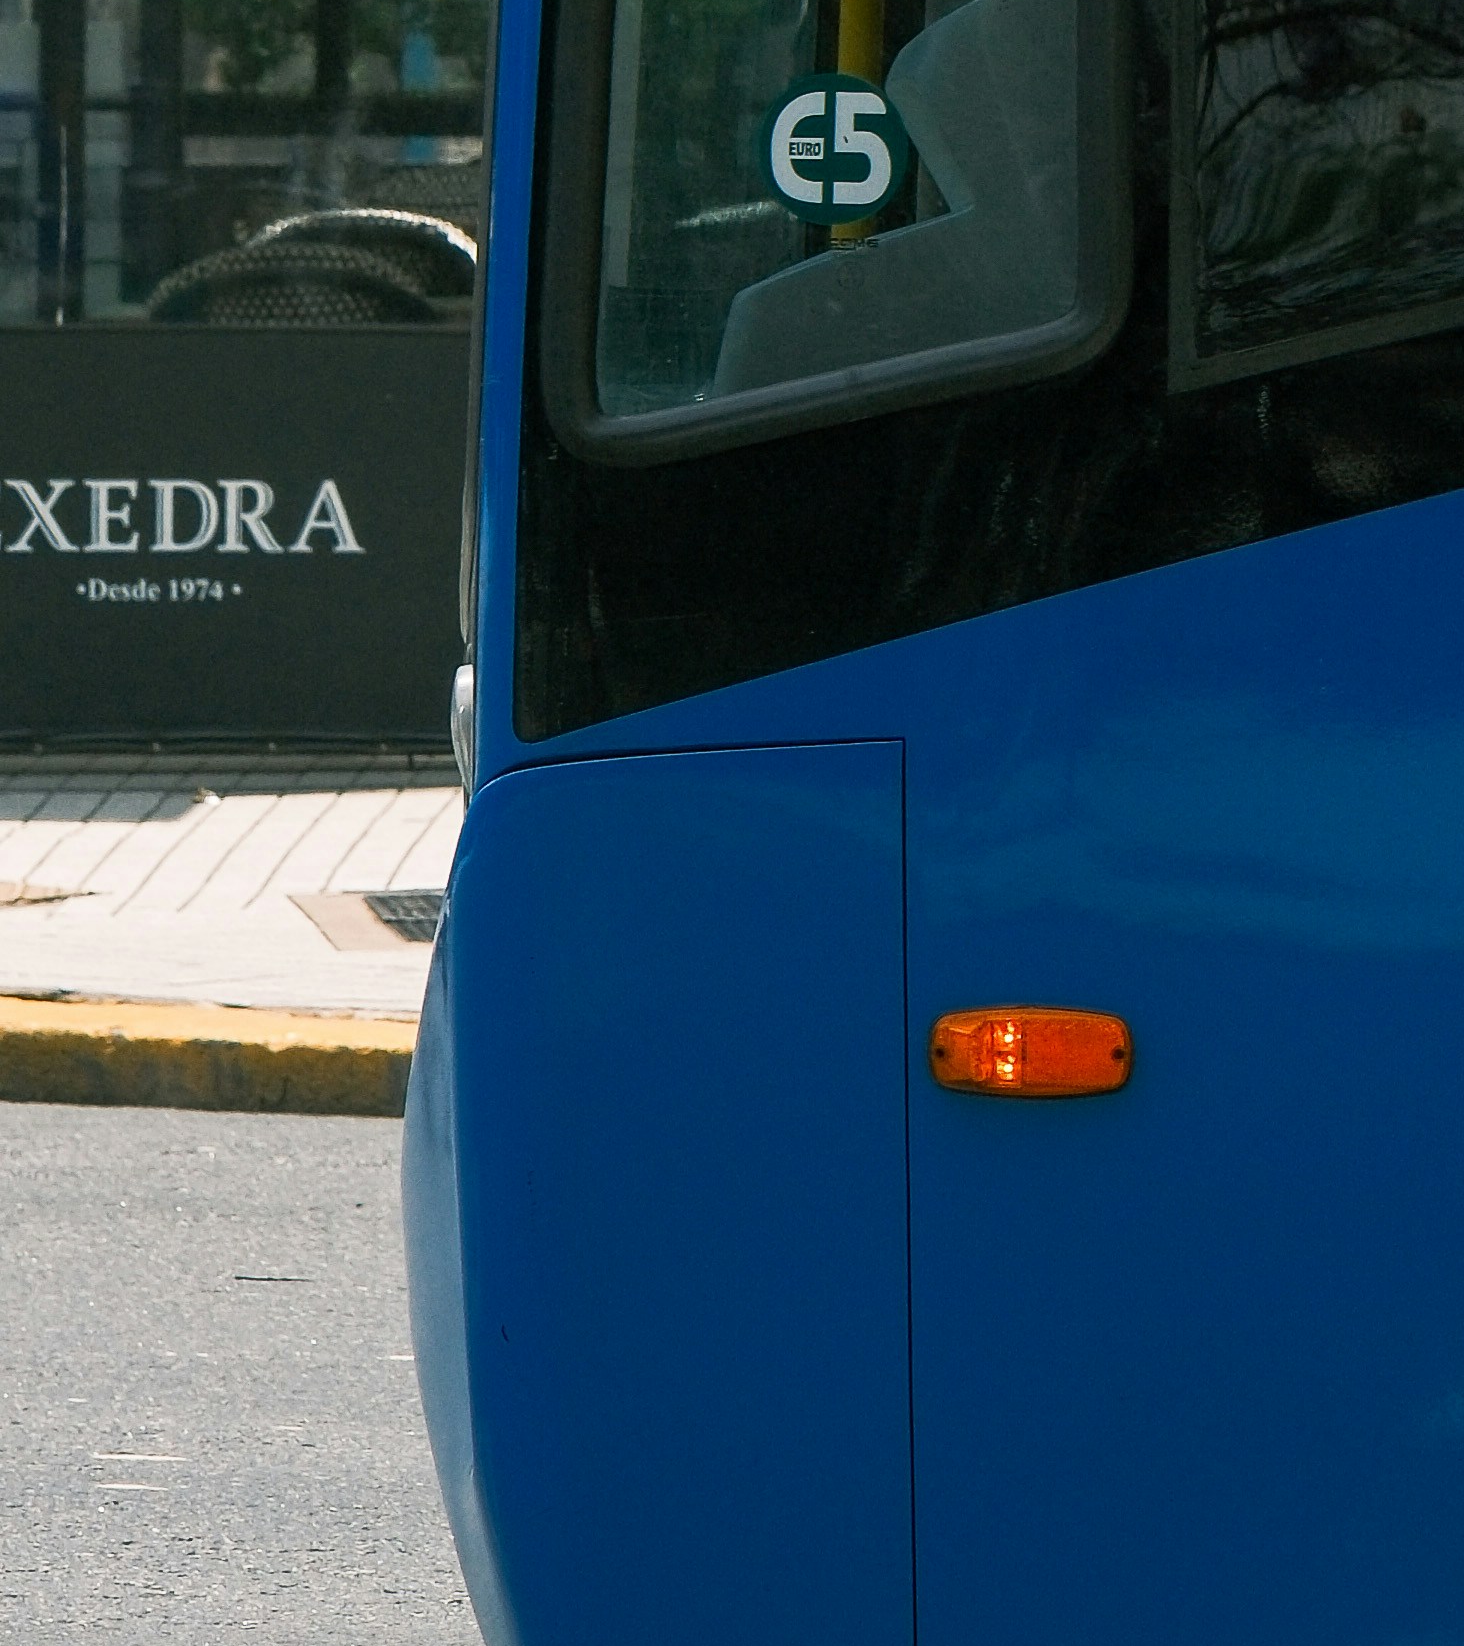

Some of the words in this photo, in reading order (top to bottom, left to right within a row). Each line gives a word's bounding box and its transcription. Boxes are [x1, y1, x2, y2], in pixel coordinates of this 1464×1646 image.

[789, 142, 822, 157] EURO
[0, 478, 367, 554] XEDRA
[86, 578, 162, 602] Desde
[168, 578, 225, 602] 1974
